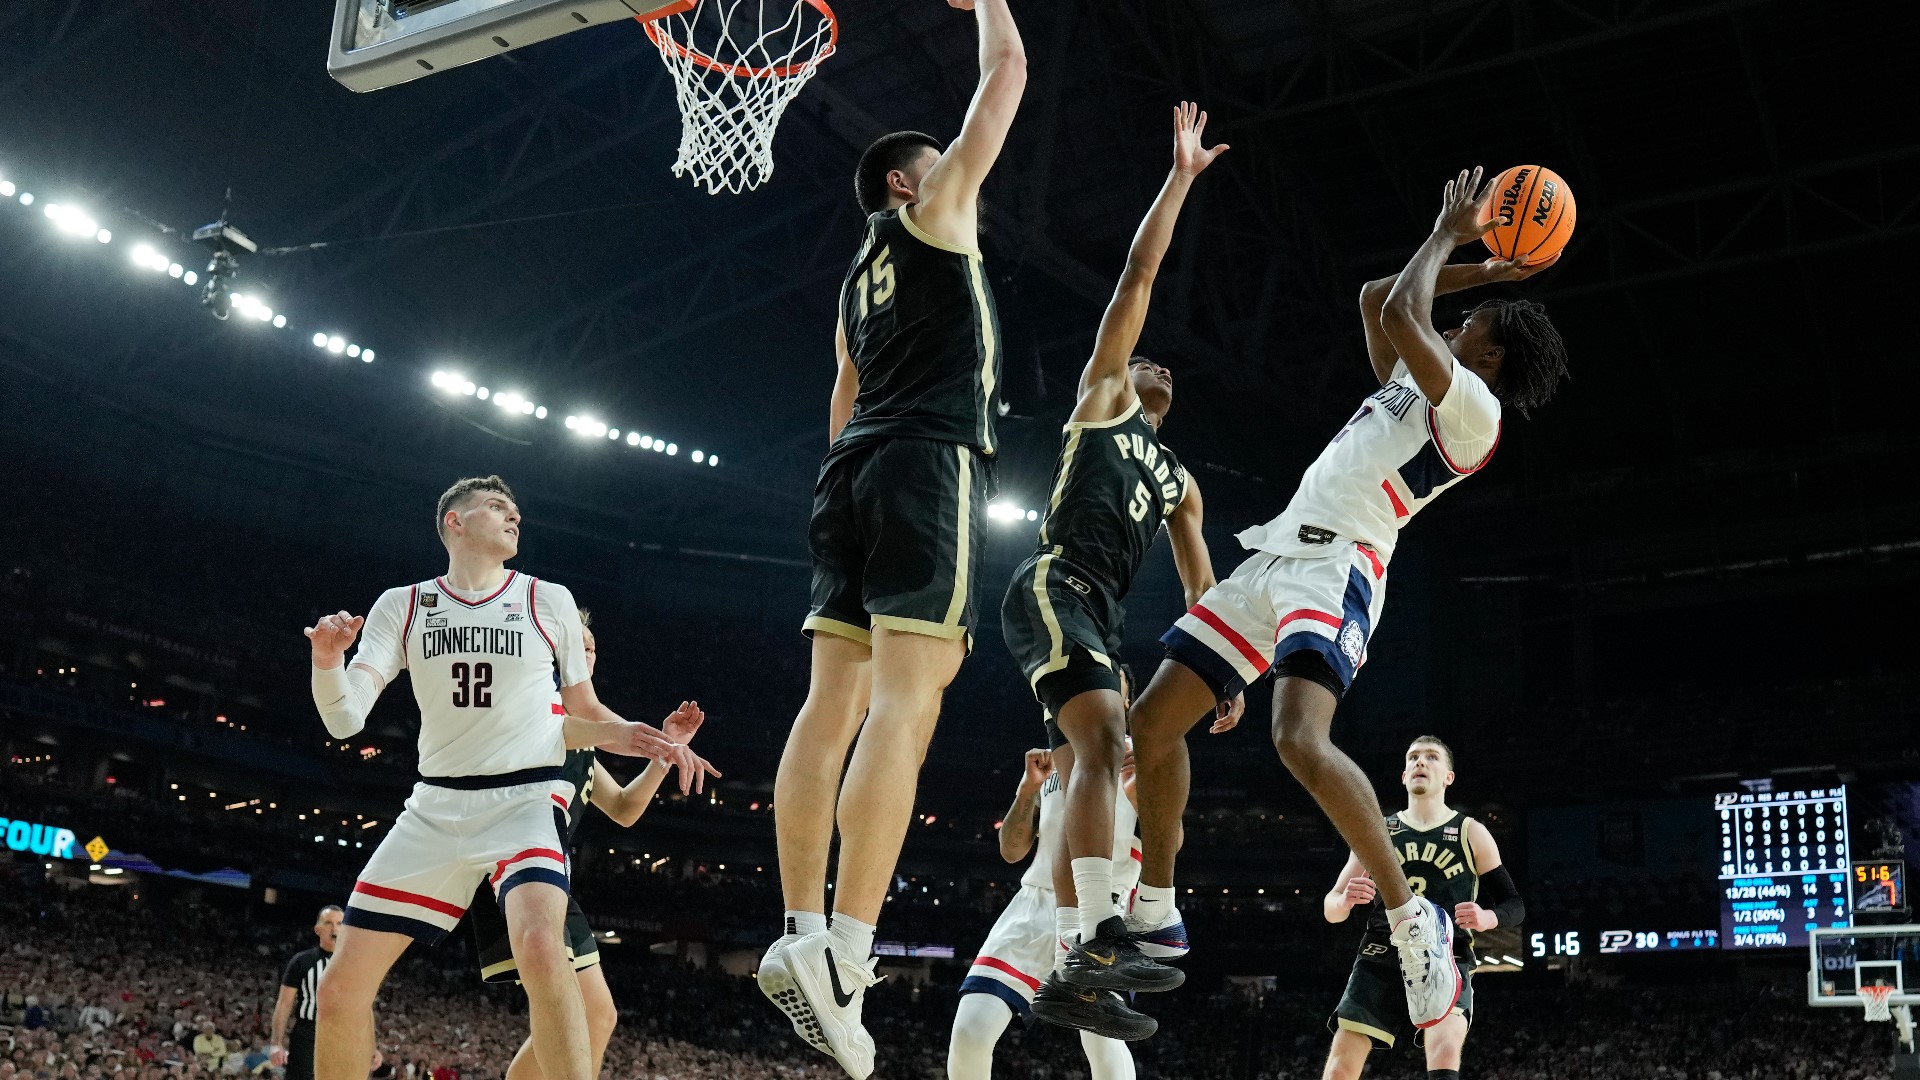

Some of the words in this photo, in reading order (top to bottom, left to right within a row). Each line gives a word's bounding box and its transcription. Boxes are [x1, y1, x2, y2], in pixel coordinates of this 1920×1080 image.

[1499, 168, 1532, 227] Wilson
[1532, 180, 1557, 227] NCAA
[856, 242, 896, 321] 15
[1128, 479, 1152, 522] 5
[422, 626, 524, 660] CONNECTICUT
[451, 662, 493, 708] 32
[1744, 808, 1752, 819] 0
[1779, 805, 1788, 817] 0
[1797, 804, 1806, 815] 0
[1815, 803, 1824, 814] 0
[1833, 801, 1842, 813] 0
[1722, 822, 1730, 834] 2
[1744, 821, 1753, 833] 0
[1762, 820, 1771, 832] 0
[1780, 818, 1789, 831] 0
[1798, 818, 1805, 829] 1
[1816, 816, 1825, 828] 0
[1834, 815, 1841, 827] 1
[1745, 835, 1754, 847] 9
[1763, 833, 1771, 846] 3
[1781, 832, 1789, 845] 3
[1798, 831, 1808, 844] 0
[1816, 830, 1826, 842] 0
[1834, 829, 1844, 841] 0
[1746, 848, 1755, 861] 0
[1764, 848, 1771, 860] 1
[1781, 846, 1790, 859] 0
[1799, 845, 1808, 857] 0
[1817, 844, 1826, 857] 0
[1835, 843, 1844, 855] 0
[1744, 863, 1758, 874] 16
[1782, 861, 1791, 872] 0
[1800, 859, 1809, 871] 0
[1818, 858, 1827, 870] 2
[1836, 857, 1845, 869] 0
[1725, 886, 1756, 899] 13/28
[1757, 884, 1791, 900] (46%)
[1802, 883, 1817, 895] 14
[1833, 882, 1842, 894] 3
[1733, 910, 1752, 923] 1/2
[1753, 908, 1785, 924] (50%)
[1807, 907, 1815, 919] 3
[1834, 906, 1844, 917] 4
[1635, 931, 1659, 949] 30
[1734, 934, 1754, 946] 3/4
[1755, 932, 1787, 947] (75%)
